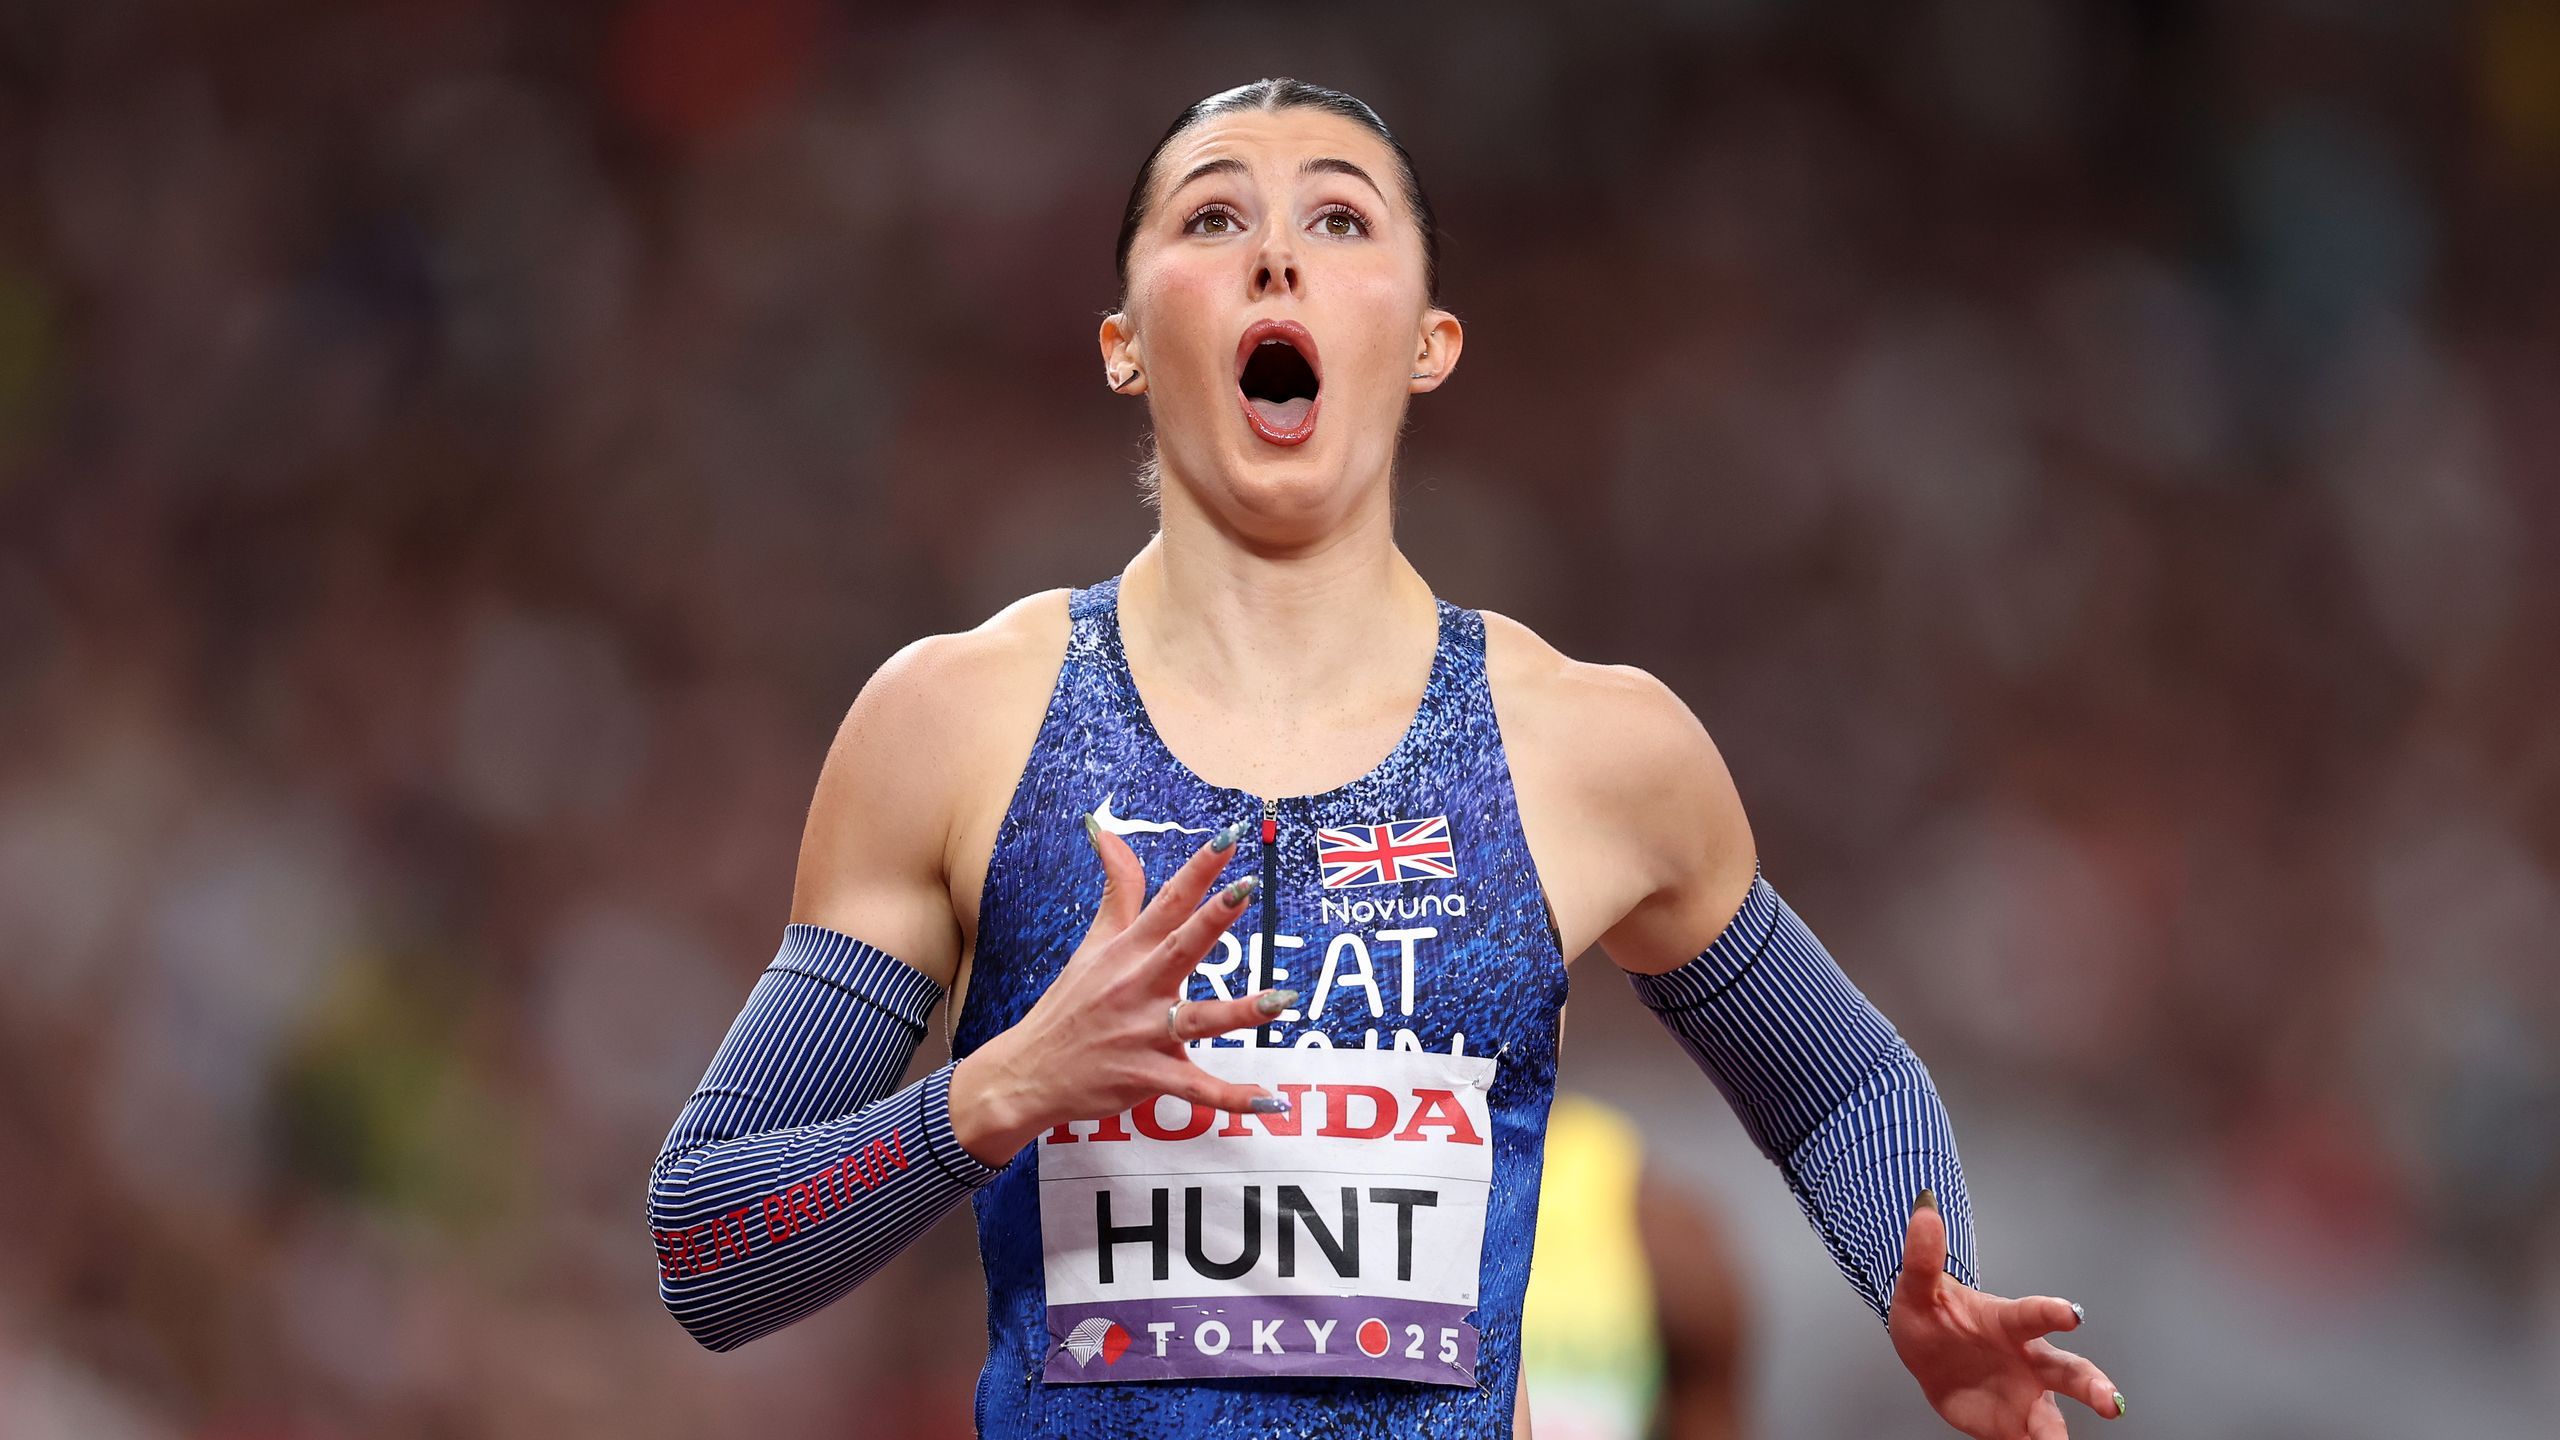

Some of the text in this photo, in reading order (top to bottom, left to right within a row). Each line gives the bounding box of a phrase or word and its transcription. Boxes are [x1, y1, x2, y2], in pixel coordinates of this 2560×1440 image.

[1321, 894, 1466, 924] Novuna
[1180, 926, 1438, 1022] REAT
[762, 1127, 908, 1244] BRITAIN
[1096, 1185, 1438, 1285] HUNT
